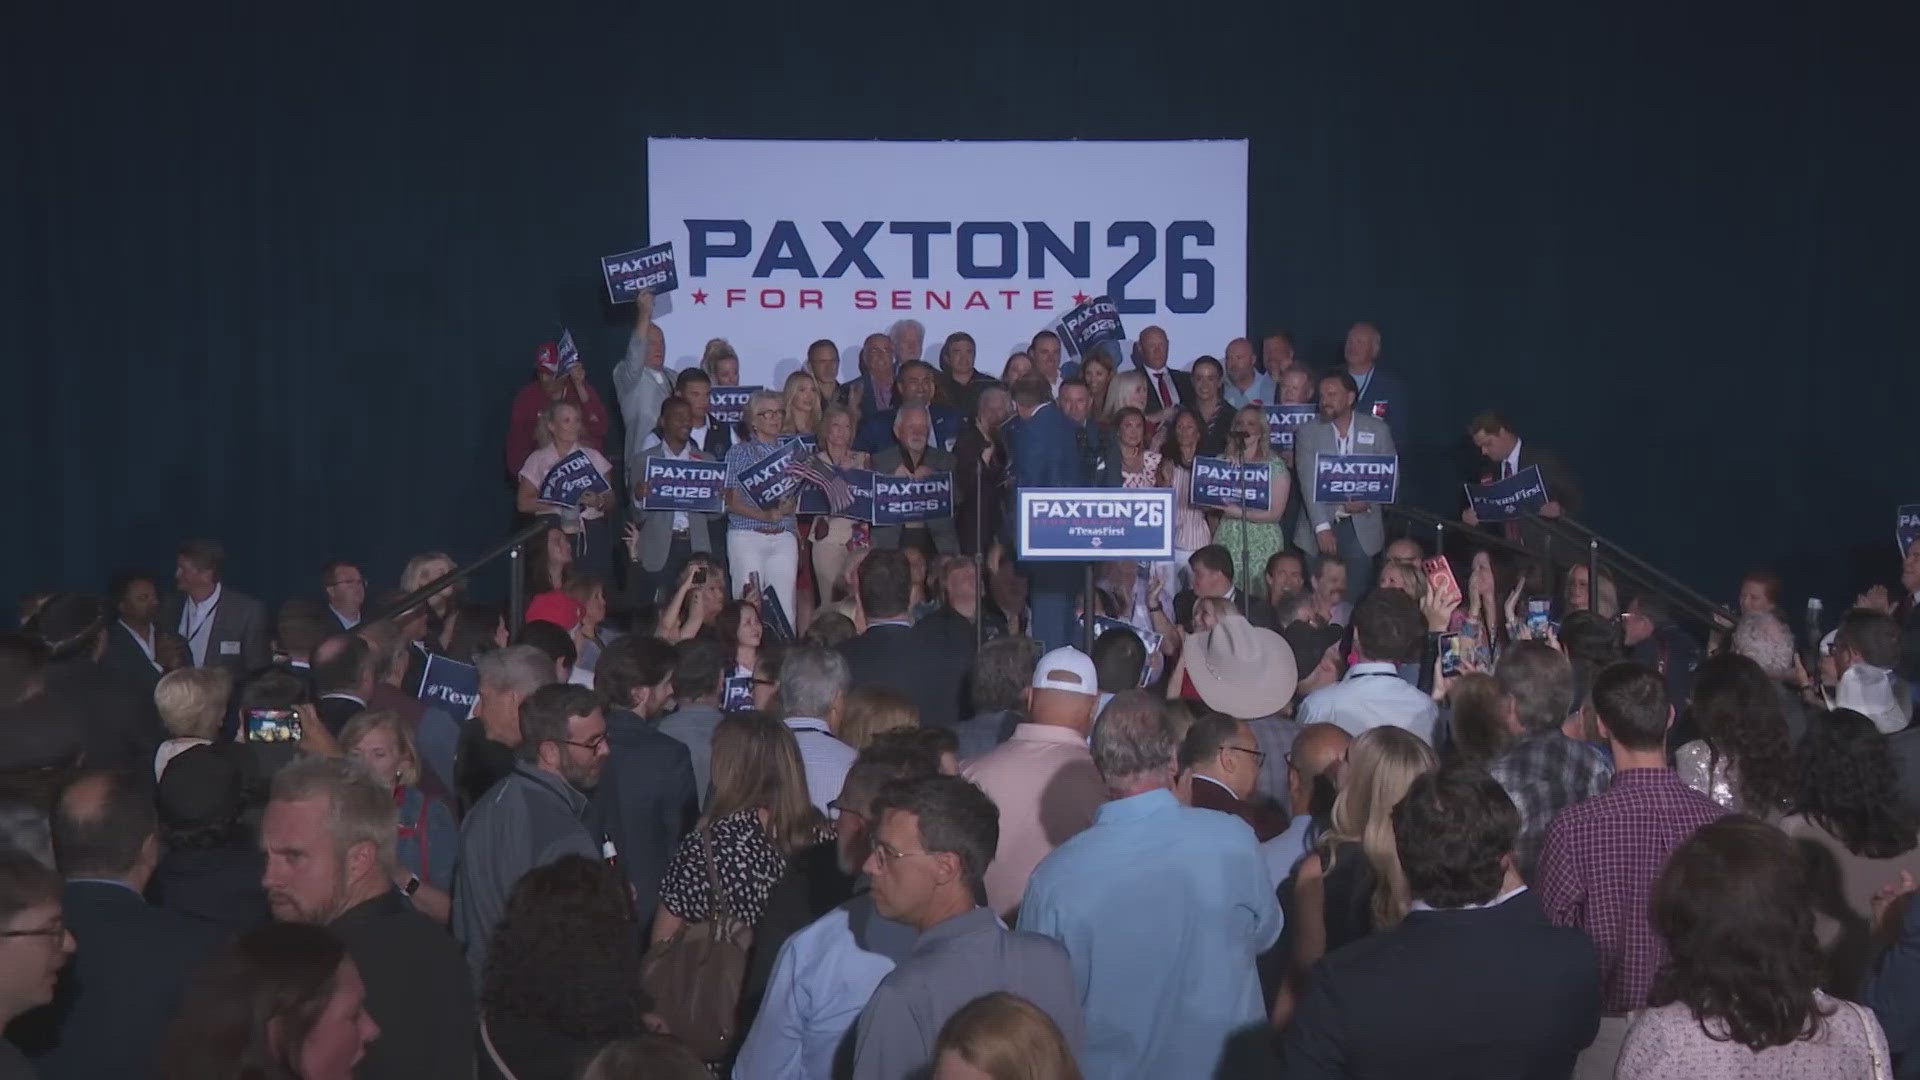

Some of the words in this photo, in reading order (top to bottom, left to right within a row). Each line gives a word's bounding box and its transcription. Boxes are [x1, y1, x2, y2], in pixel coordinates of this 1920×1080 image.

[607, 249, 674, 276] PAXTON
[683, 219, 1091, 279] PAXTON
[1106, 219, 1216, 314] 26
[623, 270, 667, 292] 2026
[726, 288, 824, 310] FOR
[855, 289, 1054, 311] SENATE
[650, 465, 726, 481] PAXTON
[1197, 464, 1268, 482] PAXTON
[1319, 461, 1395, 475] PAXTON
[660, 484, 712, 499] 2026
[876, 480, 950, 496] PAXTON
[1330, 480, 1381, 492] 2026
[888, 499, 939, 513] 2026
[1032, 501, 1132, 519] PAXTON
[1133, 502, 1163, 527] 26
[1068, 526, 1125, 537] #TexasFirst
